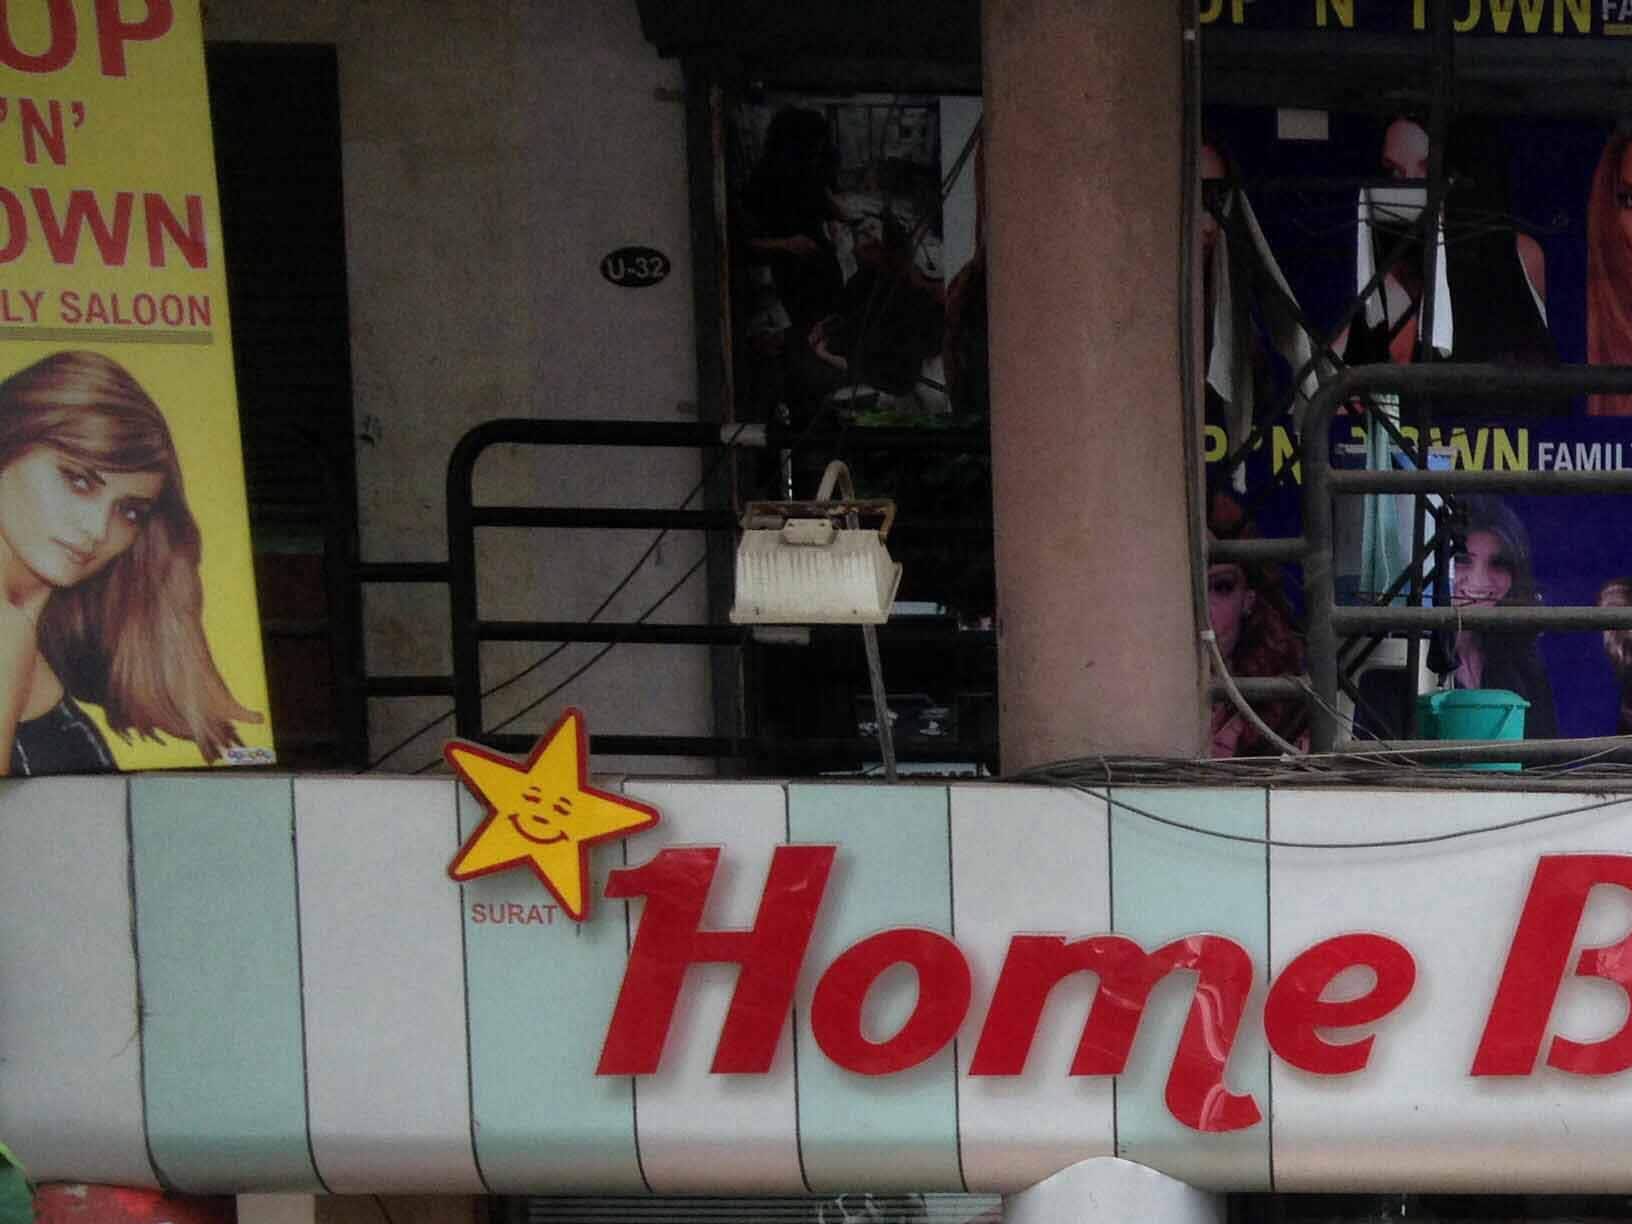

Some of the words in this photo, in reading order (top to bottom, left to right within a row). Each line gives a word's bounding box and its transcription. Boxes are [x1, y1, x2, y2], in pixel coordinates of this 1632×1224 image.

[607, 256, 664, 279] U-32
[60, 291, 211, 327] SALOON
[471, 903, 558, 925] SURAT
[594, 845, 1417, 1132] Home
